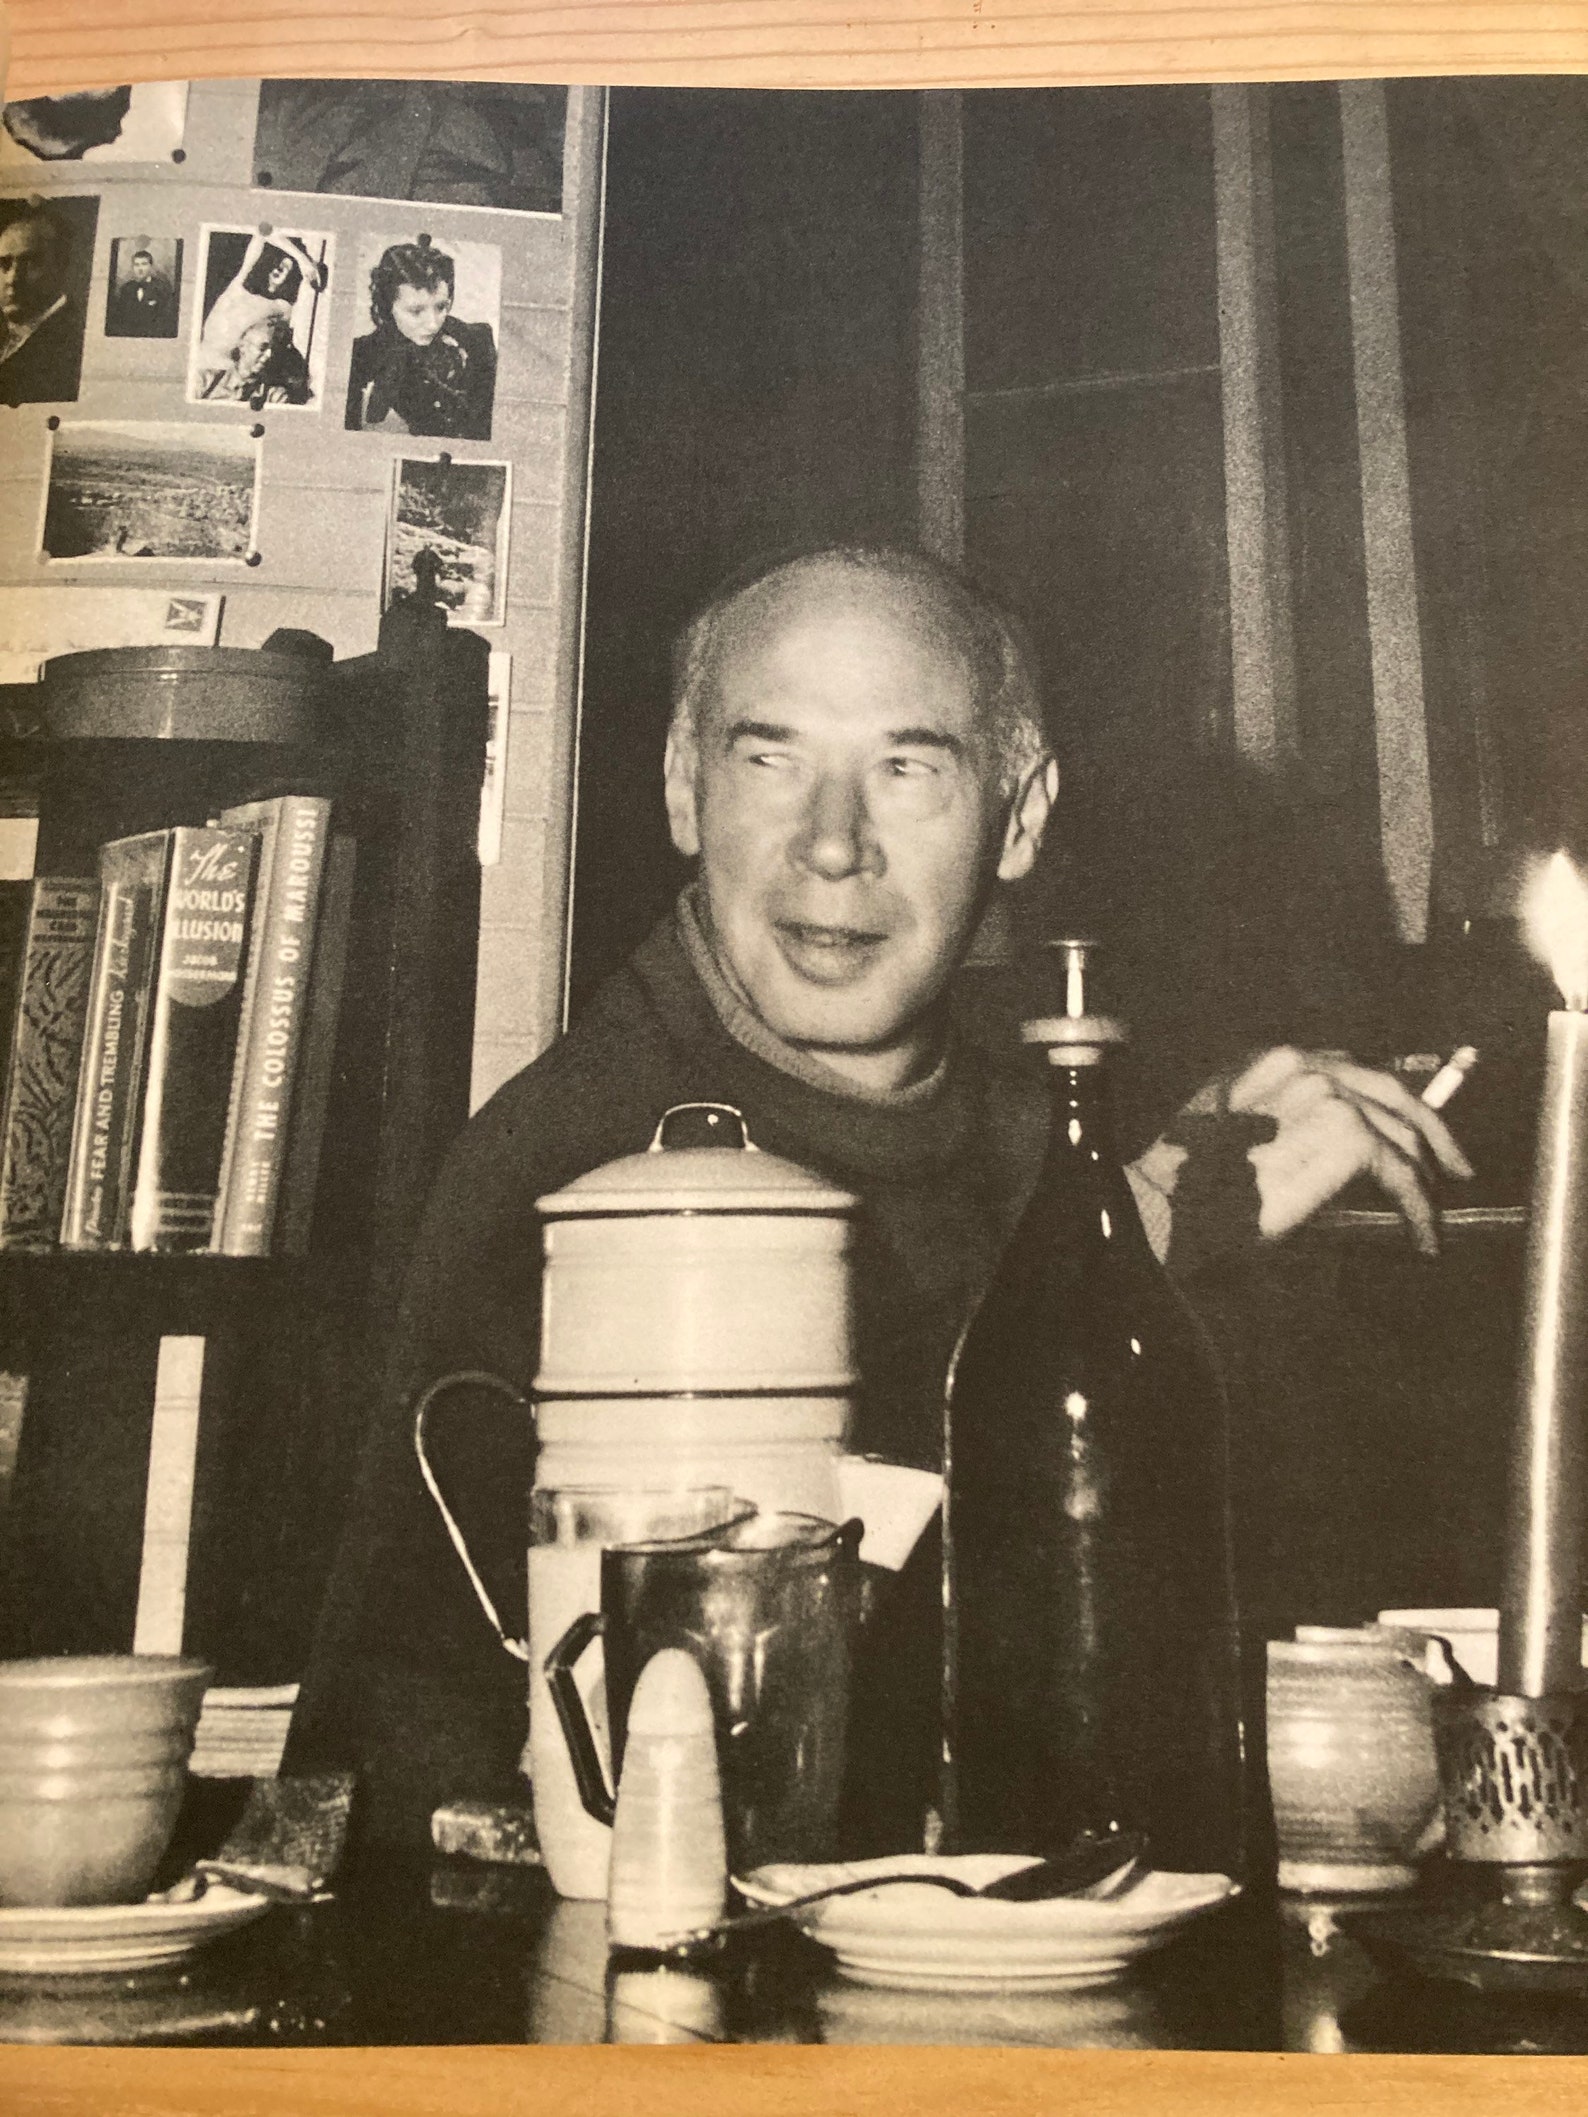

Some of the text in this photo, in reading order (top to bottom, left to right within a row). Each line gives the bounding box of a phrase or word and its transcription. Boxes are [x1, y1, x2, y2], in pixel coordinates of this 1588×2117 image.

[184, 842, 239, 886] The
[254, 809, 319, 1140] THE COLOSSUS OF MAROUSSI
[100, 989, 125, 1087] TREMBLING
[95, 1088, 113, 1130] AND
[90, 1134, 109, 1180] FEAR
